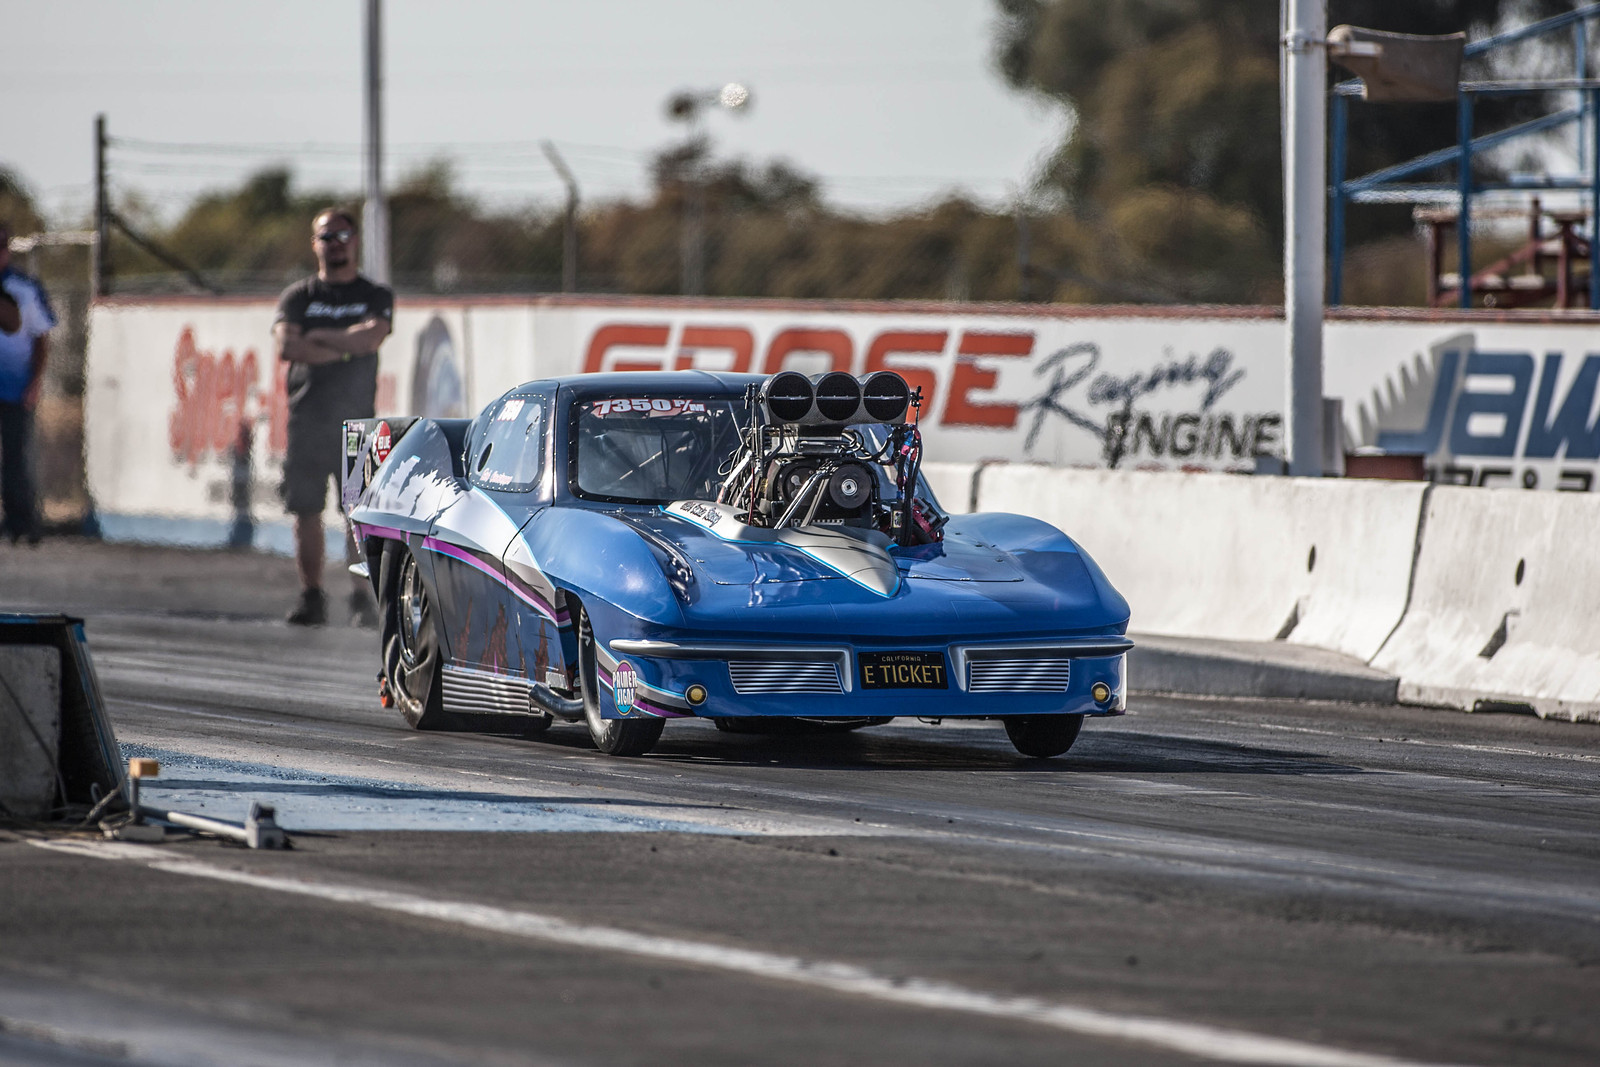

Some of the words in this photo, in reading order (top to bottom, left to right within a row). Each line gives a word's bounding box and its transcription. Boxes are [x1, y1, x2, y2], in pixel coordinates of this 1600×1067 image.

[594, 399, 672, 416] 7350
[612, 671, 638, 688] PALMER
[864, 665, 875, 684] E
[879, 664, 942, 684] TICKET
[617, 688, 634, 706] SIGNS
